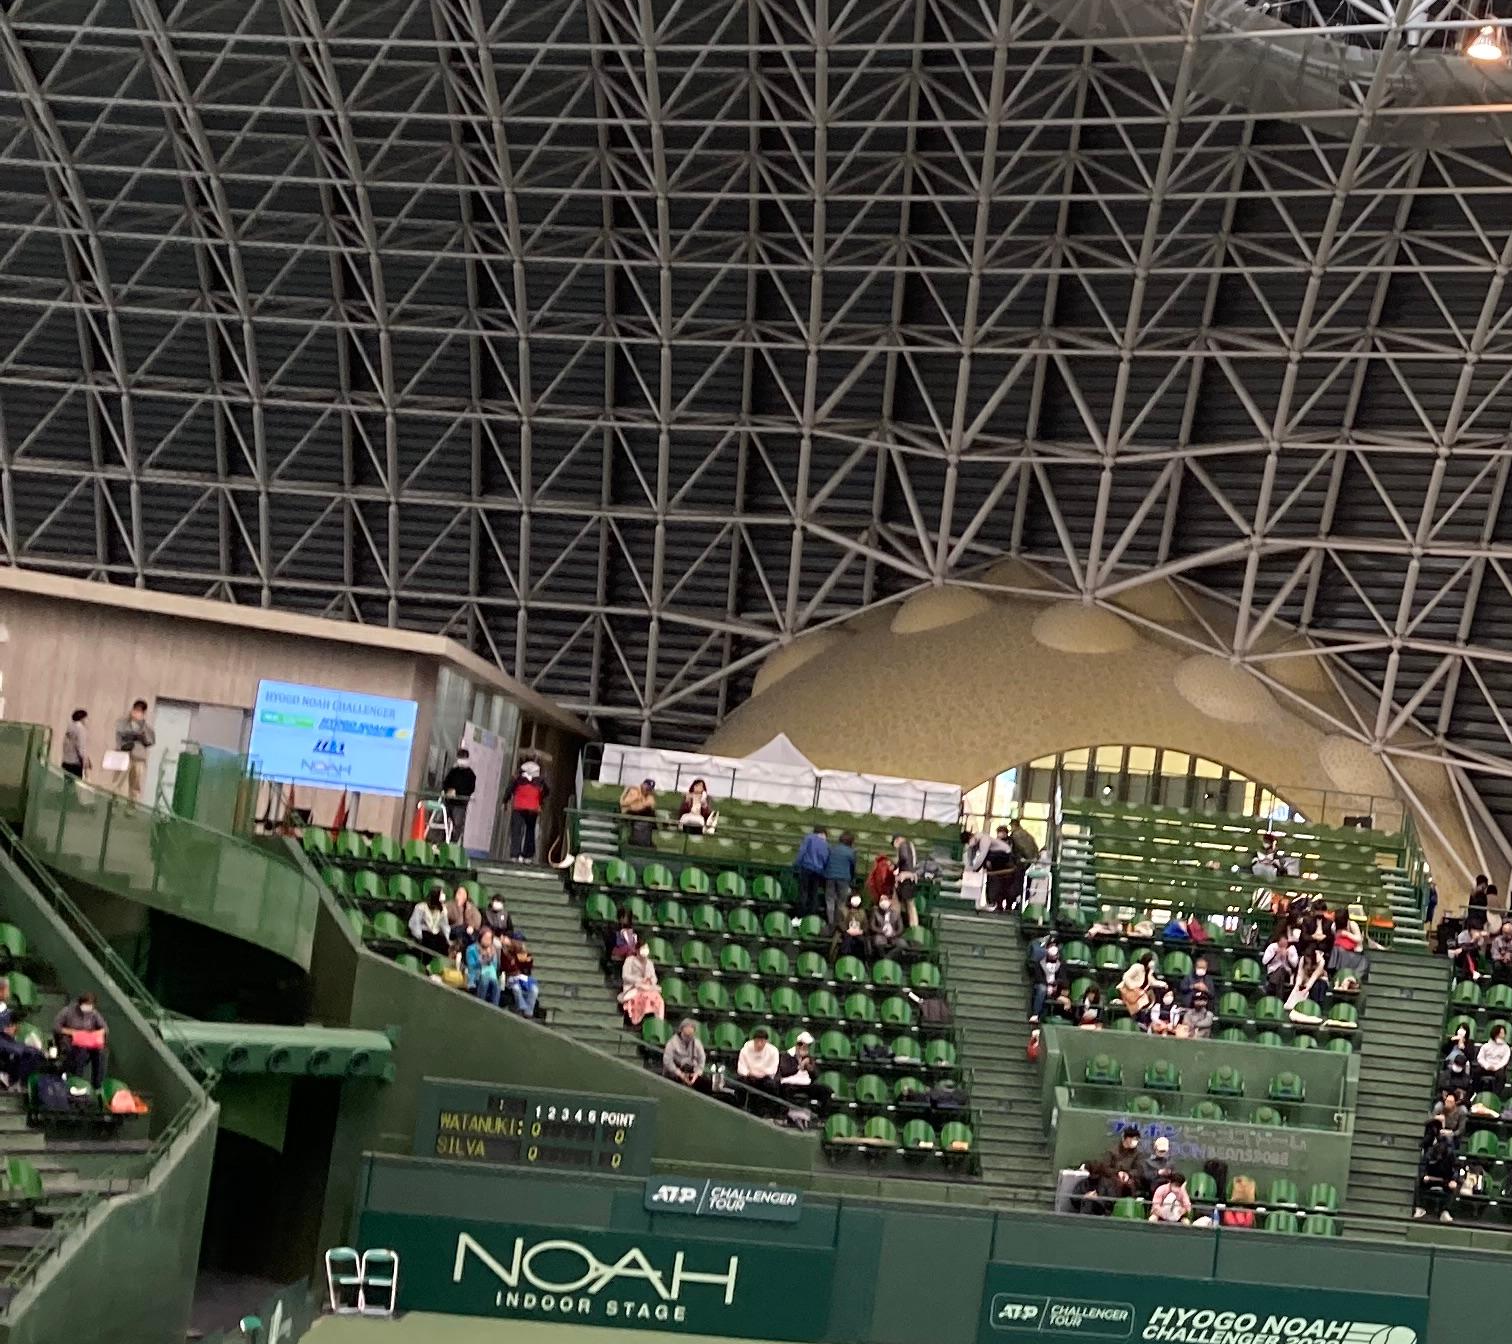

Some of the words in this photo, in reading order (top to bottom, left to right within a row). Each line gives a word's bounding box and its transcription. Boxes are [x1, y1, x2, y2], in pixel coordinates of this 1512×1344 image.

[535, 1105, 541, 1118] 1
[548, 1106, 556, 1120] 2
[561, 1107, 570, 1122] 3
[574, 1109, 583, 1123] 4
[600, 1111, 635, 1128] POINT
[436, 1136, 485, 1156] SILVA
[652, 1184, 698, 1204] ATP
[710, 1185, 797, 1207] CHALLENGER
[709, 1198, 746, 1213] TOUR
[453, 1231, 739, 1305] NOAH
[495, 1291, 592, 1315] INDOOR
[605, 1300, 687, 1322] STAGE
[998, 1303, 1038, 1321] ATP
[1051, 1304, 1129, 1322] CHALLENGER
[1049, 1314, 1083, 1328] TOUR
[1148, 1306, 1258, 1333] HYOGO
[1259, 1311, 1351, 1341] NOAH
